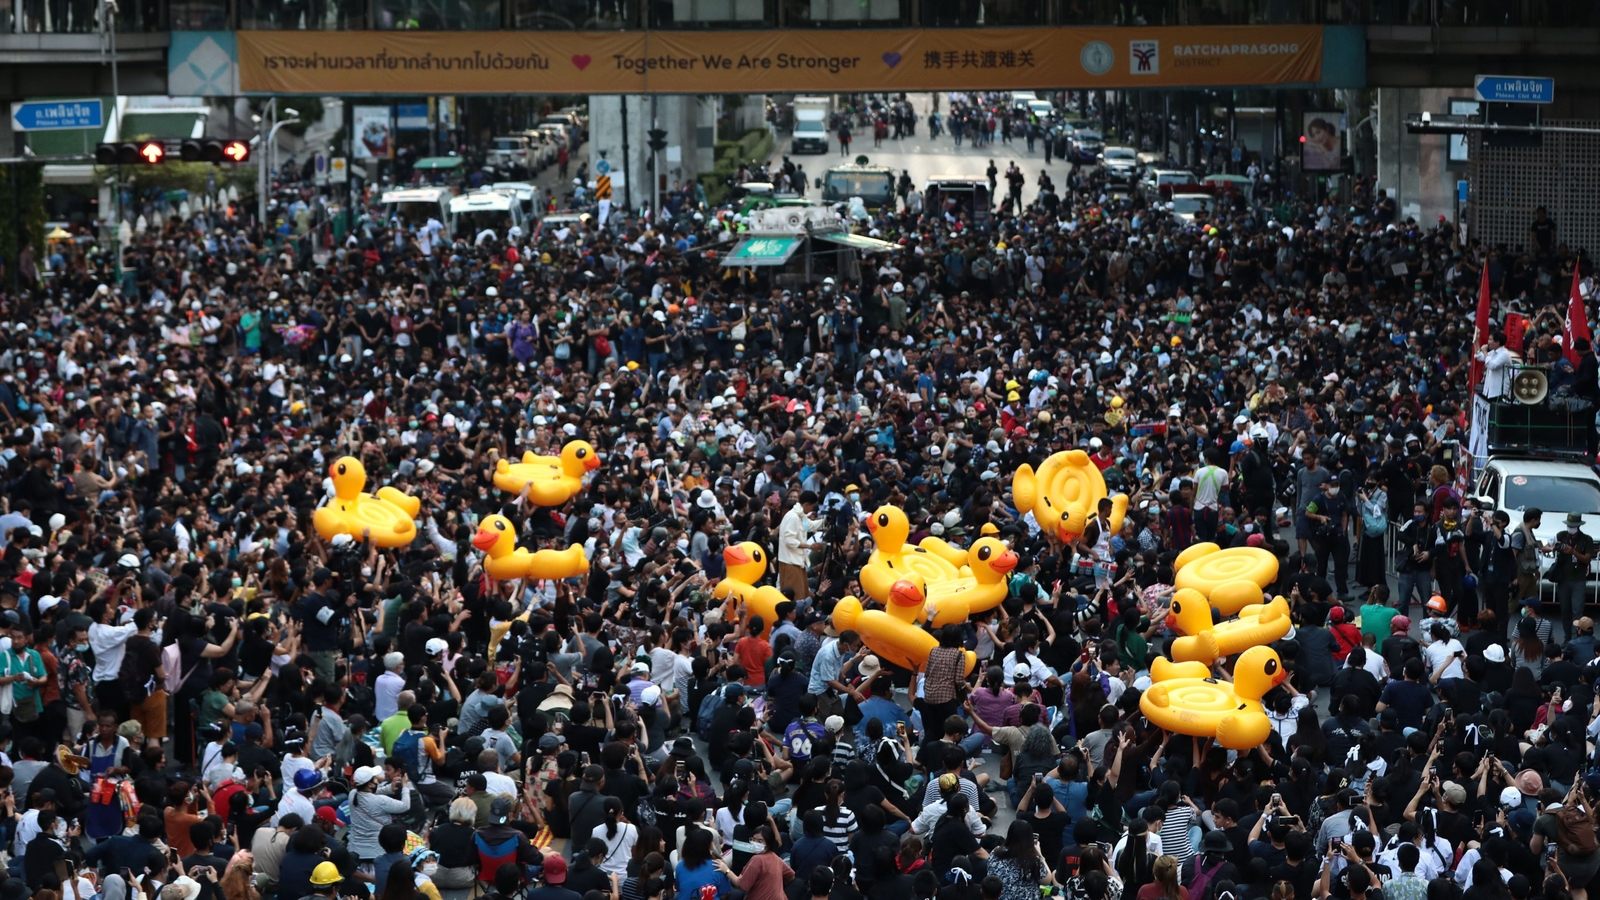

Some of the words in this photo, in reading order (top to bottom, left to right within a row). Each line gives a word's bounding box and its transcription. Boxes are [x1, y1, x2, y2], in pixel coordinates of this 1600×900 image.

[1173, 43, 1299, 57] RATCHAPRASONG
[264, 47, 549, 70] เราจะผ่านเวลาที่ยากลำบากไปด้วยกัน
[613, 54, 698, 74] Together
[702, 54, 733, 69] We
[737, 54, 771, 69] Are
[777, 53, 860, 74] Stronger
[923, 50, 1035, 69] 携手共渡难关
[1173, 57, 1222, 68] DISTRICT
[460, 770, 478, 778] ANTI
